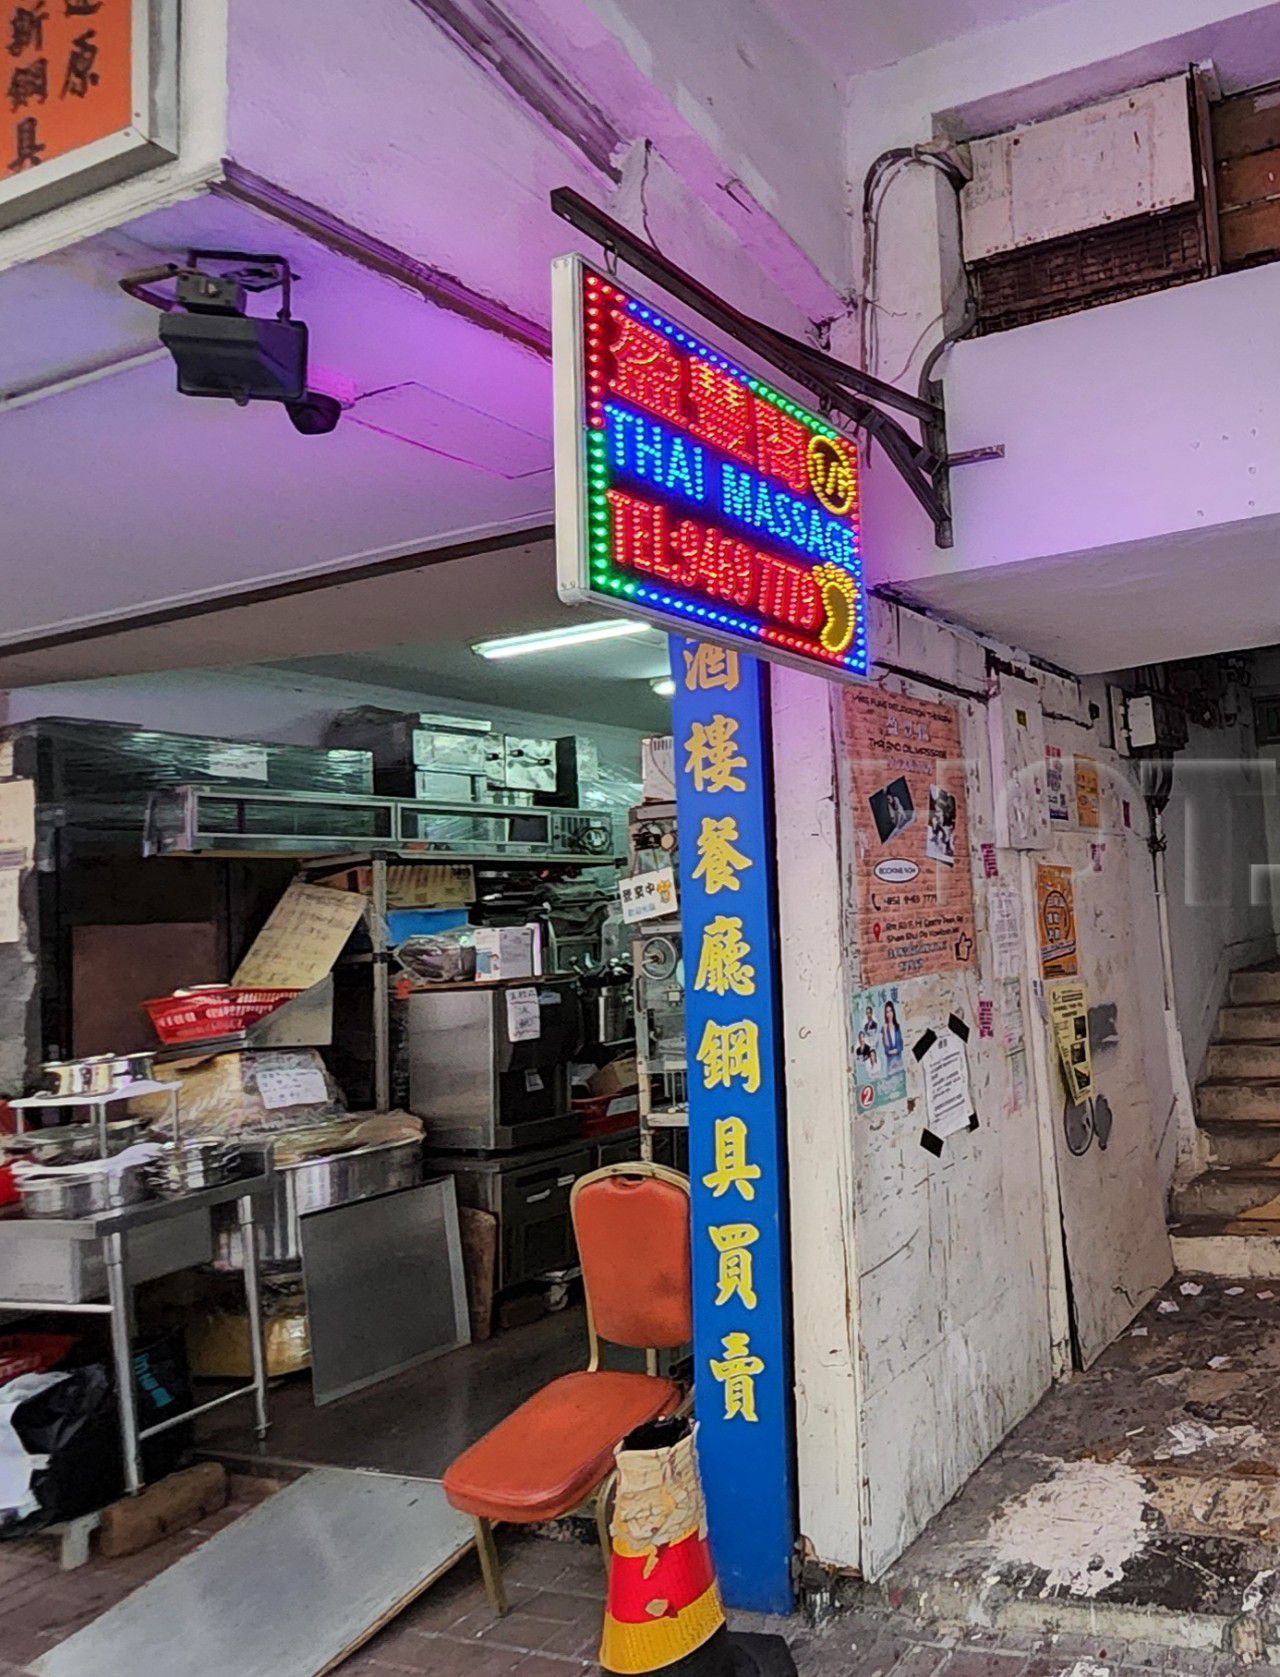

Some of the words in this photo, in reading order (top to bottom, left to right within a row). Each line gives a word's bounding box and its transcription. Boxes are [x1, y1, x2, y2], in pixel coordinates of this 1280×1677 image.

[603, 402, 707, 501] THAI
[722, 462, 862, 572] MASSAGE
[863, 1087, 873, 1105] 2
